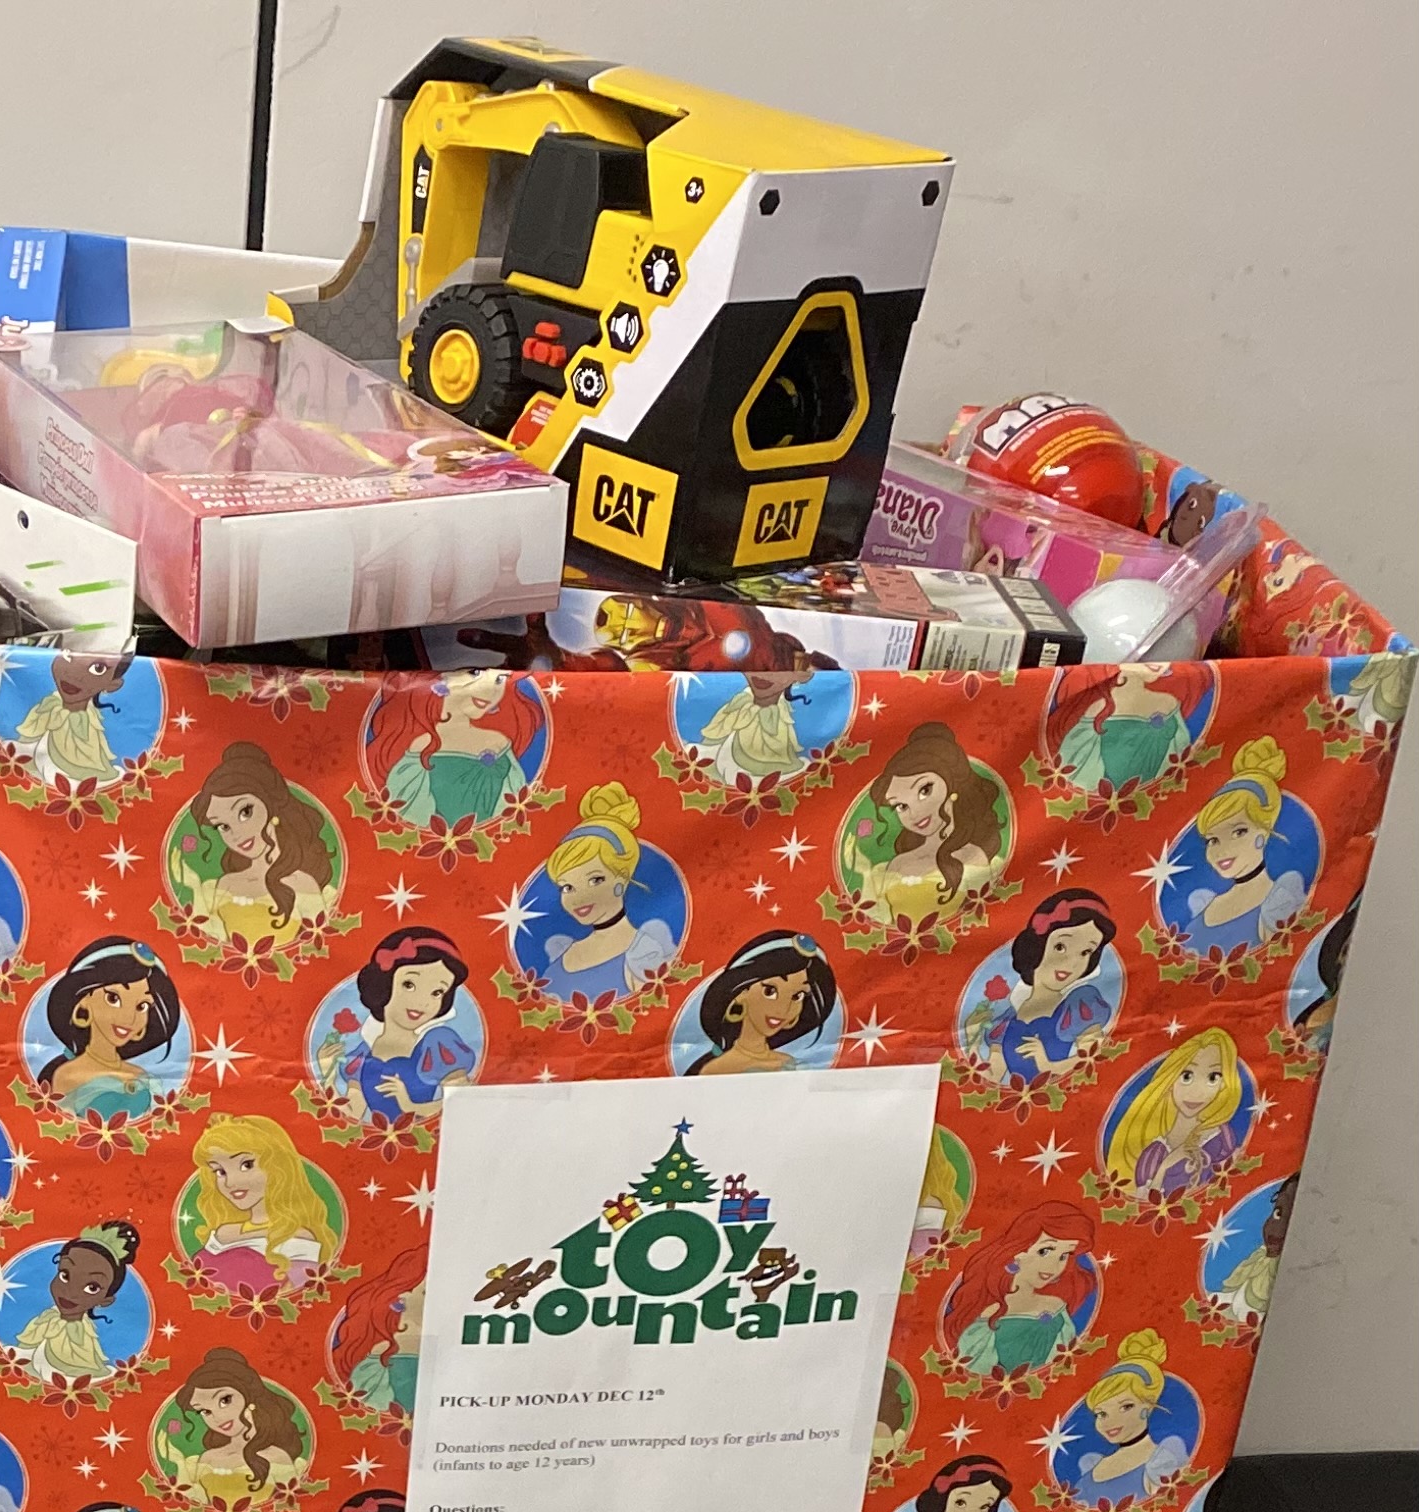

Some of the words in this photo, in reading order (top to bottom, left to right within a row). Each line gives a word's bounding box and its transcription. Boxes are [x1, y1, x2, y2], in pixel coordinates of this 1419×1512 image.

[415, 166, 430, 199] CAT
[687, 182, 704, 198] 3+
[592, 474, 657, 538] CAT
[753, 499, 811, 545] CAT
[461, 1268, 859, 1345] mountain
[439, 1395, 511, 1408] PICK-UP
[515, 1391, 593, 1407] MONDAY
[597, 1389, 634, 1403] DEC
[435, 1441, 505, 1454] Donations
[508, 1439, 557, 1452] needed
[560, 1437, 577, 1449] of
[578, 1439, 606, 1449] new
[610, 1434, 686, 1450] unwrapped
[690, 1435, 719, 1448] toys
[723, 1433, 744, 1446] for
[746, 1432, 777, 1447] girls
[780, 1430, 804, 1441] and
[808, 1428, 840, 1444] boys
[432, 1459, 485, 1473] (infants
[489, 1460, 503, 1470] to
[506, 1460, 530, 1472] age
[534, 1457, 550, 1468] 12
[554, 1455, 596, 1470] years)
